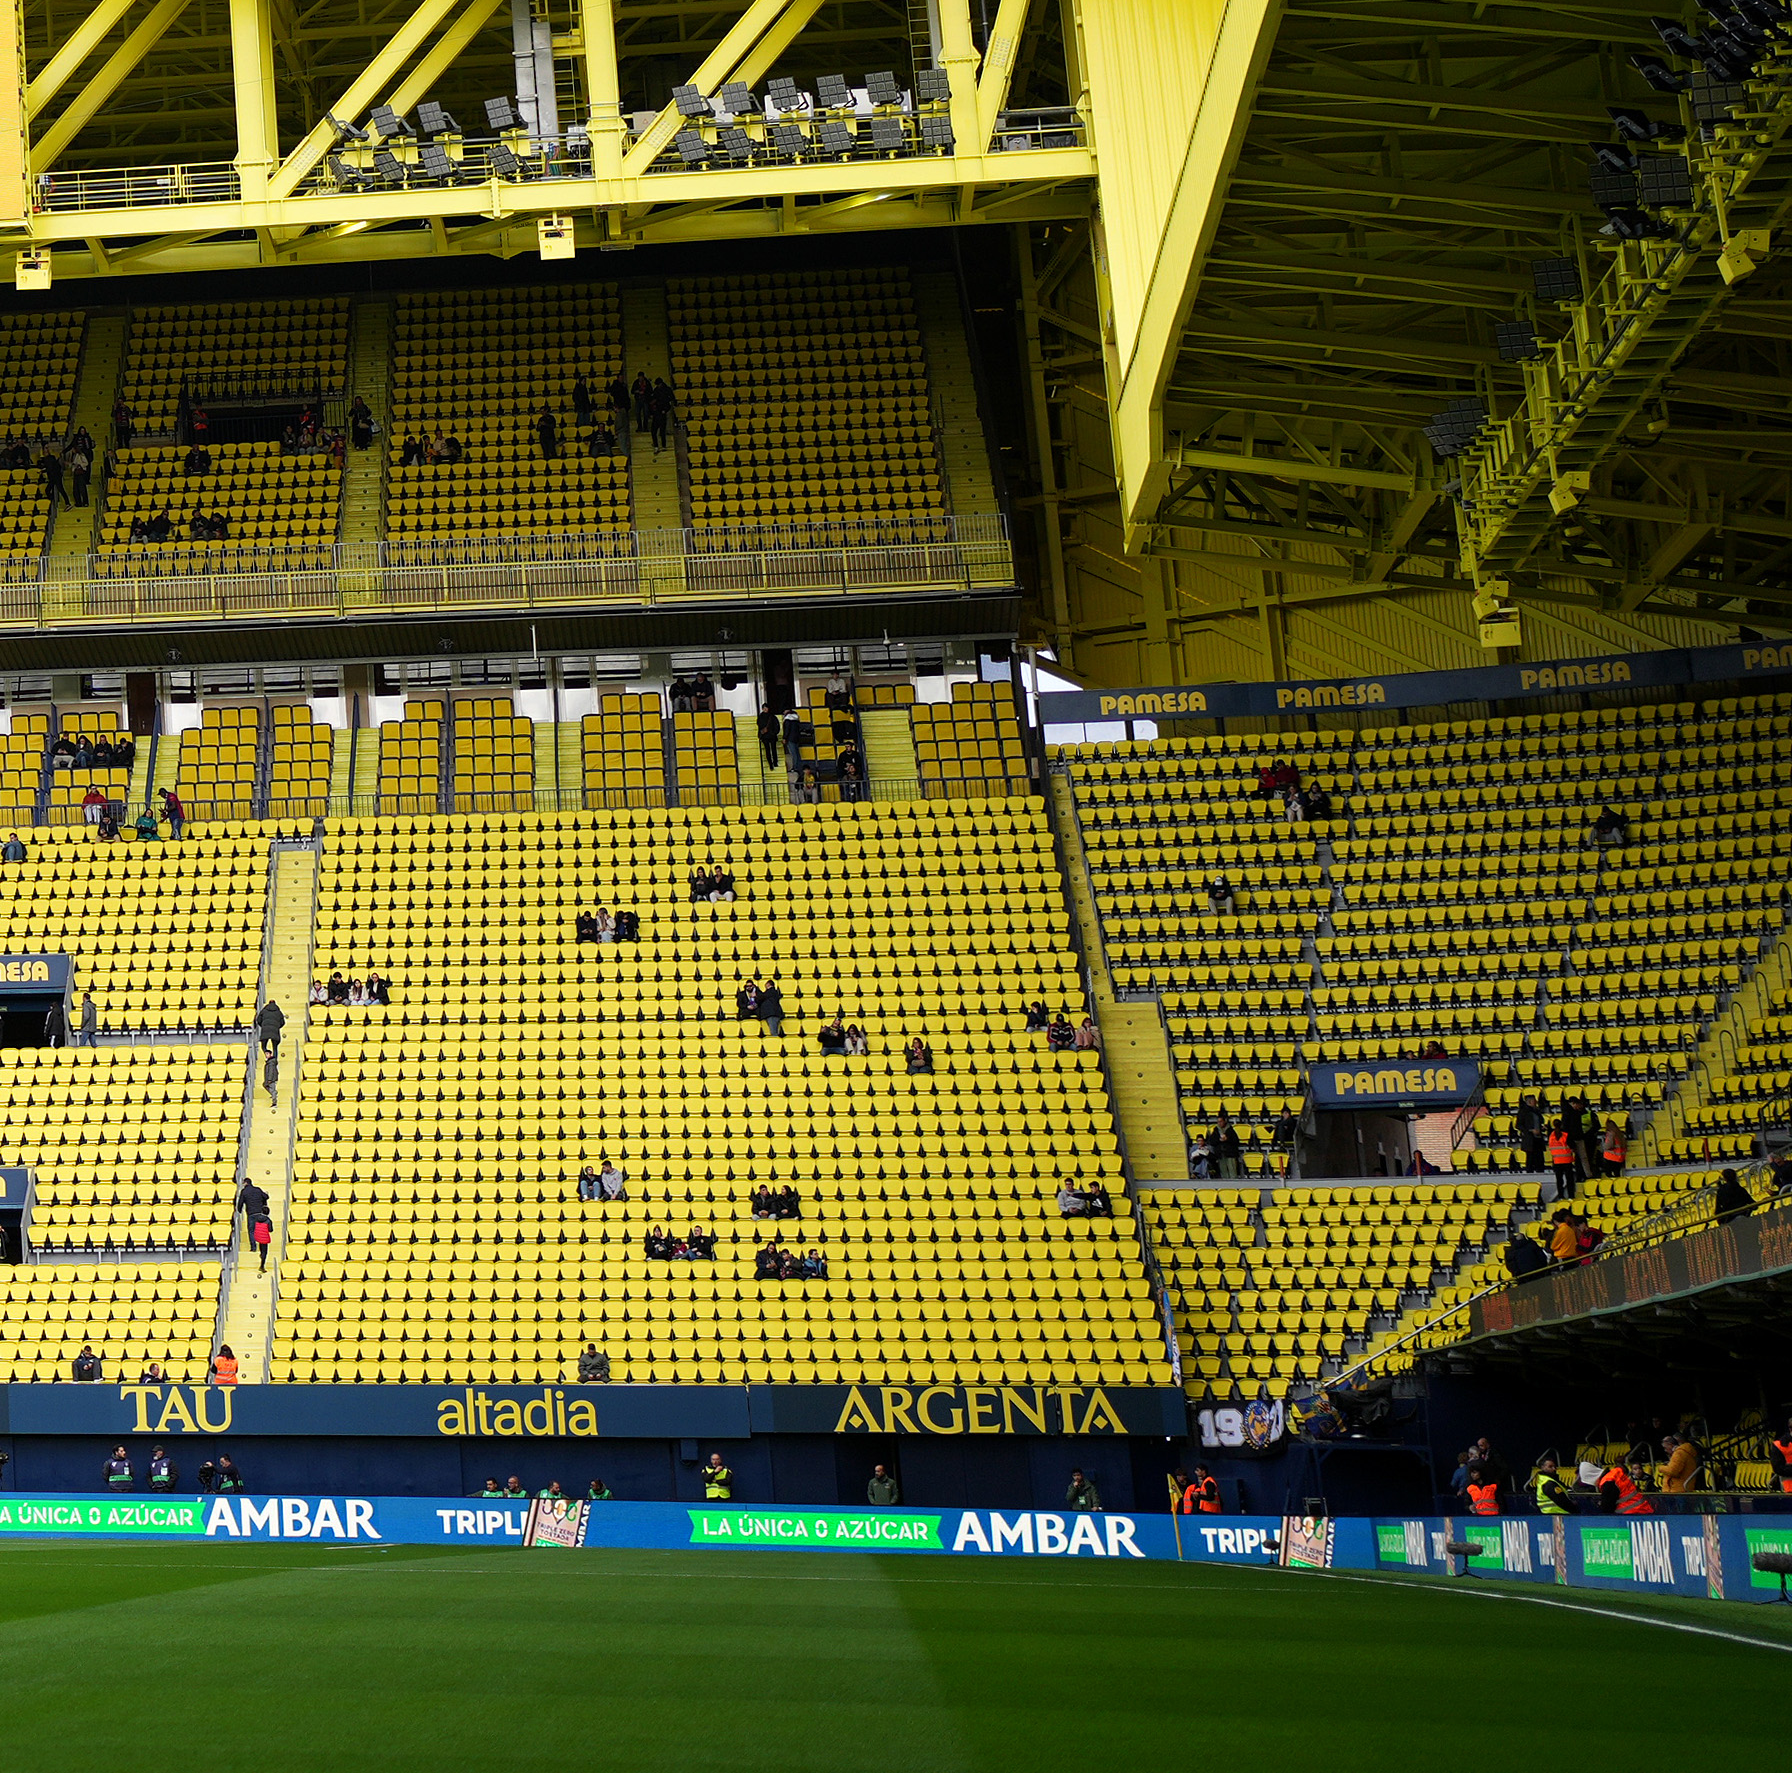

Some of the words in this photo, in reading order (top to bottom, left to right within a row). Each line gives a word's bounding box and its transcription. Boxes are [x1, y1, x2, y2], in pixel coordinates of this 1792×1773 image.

[1520, 661, 1632, 690] PAMESA
[1100, 691, 1207, 715] PAMESA
[1277, 683, 1386, 708] PAMESA
[1334, 1068, 1457, 1095] PAMESA
[120, 1386, 236, 1433] TAU
[436, 1388, 598, 1436] altadia
[833, 1387, 1129, 1434] ARGENTA
[18, 1503, 81, 1524] ÚNICA
[109, 1504, 194, 1526] AZÚCAR
[703, 1518, 732, 1535] LA
[739, 1514, 808, 1537] ÚNICA
[836, 1517, 928, 1541] AZÚCAR
[952, 1511, 1146, 1558] AMBAR
